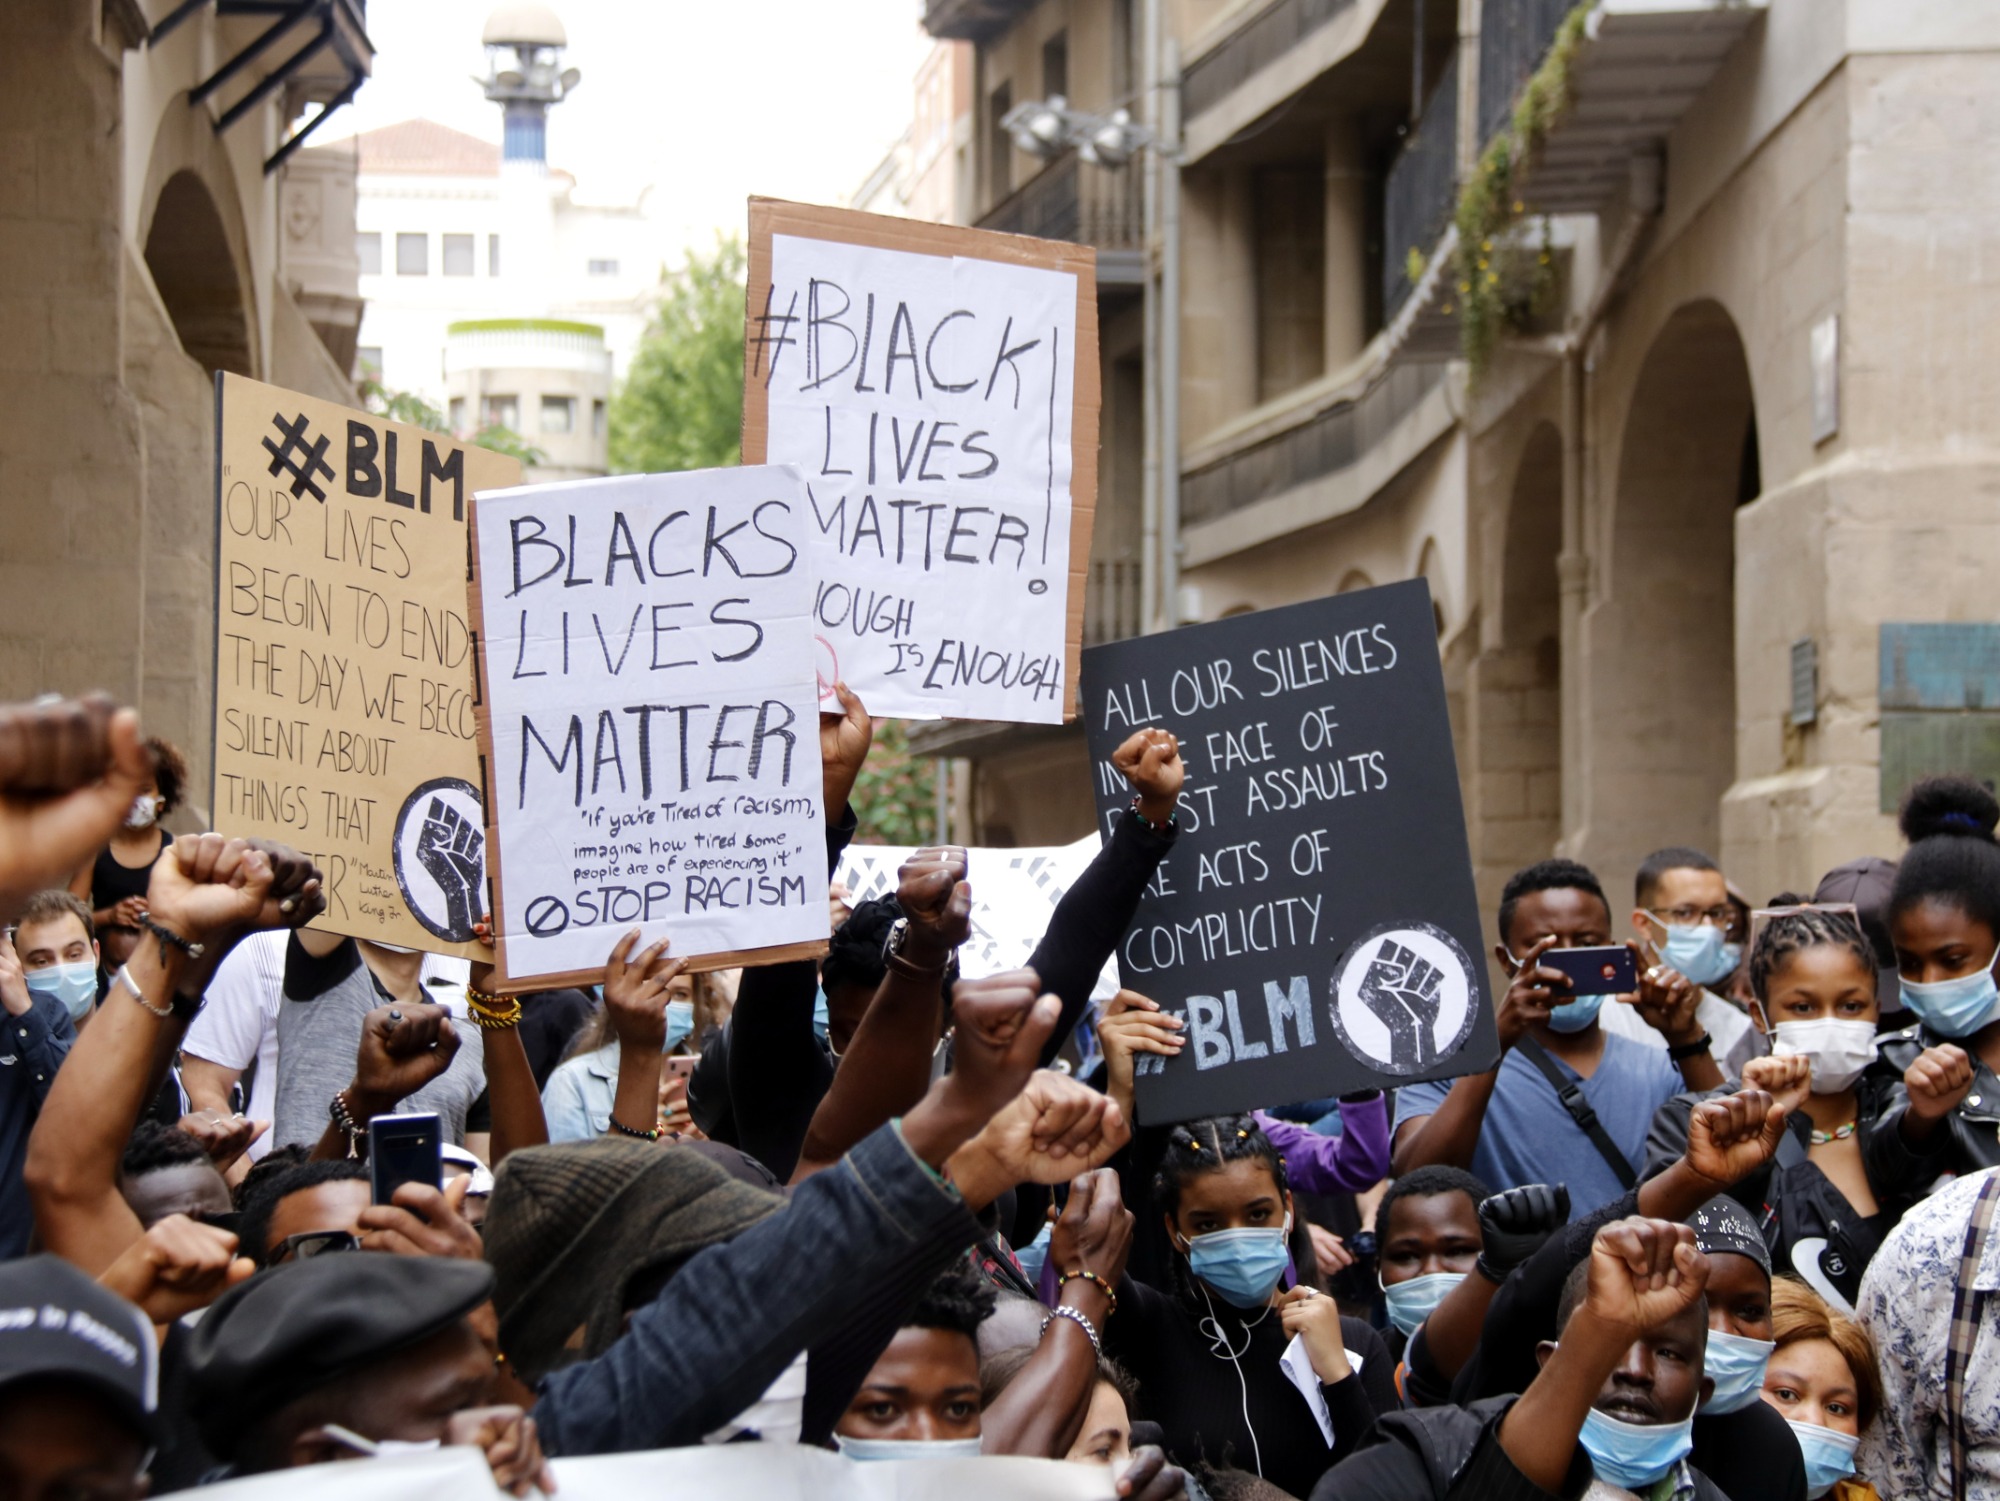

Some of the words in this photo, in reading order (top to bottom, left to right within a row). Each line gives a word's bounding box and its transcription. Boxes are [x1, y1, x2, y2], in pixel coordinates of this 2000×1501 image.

[749, 277, 1042, 411] #BLACK
[260, 411, 465, 523] #BLM
[820, 405, 1000, 486] LIVES
[324, 504, 411, 579] LIVES
[504, 500, 798, 599] BLACKS
[229, 560, 332, 636] BEGIN
[345, 584, 390, 649] TO
[401, 600, 469, 669] END
[512, 597, 765, 681] LIVES
[813, 580, 915, 639] OUGH
[223, 632, 287, 698] THE
[299, 649, 348, 711] DAY
[357, 665, 407, 725] WE
[921, 638, 1062, 702] ENOUGH
[1103, 678, 1164, 732] ALL
[1170, 658, 1245, 717] OUR
[1252, 622, 1398, 698] SILENCES
[224, 708, 310, 766] SILENT
[317, 728, 396, 777] ABOUT
[517, 699, 798, 811] MATTER
[1098, 759, 1129, 797] IN
[1206, 722, 1277, 774] FACE
[1300, 705, 1340, 752] OF
[220, 773, 309, 830] THINGS
[320, 790, 378, 846] THAT
[704, 796, 726, 819] of
[1247, 750, 1389, 818] ASSAULTS
[359, 861, 394, 882] Martin
[573, 841, 642, 865] imagine
[648, 836, 687, 856] how
[694, 831, 737, 850] tired
[742, 832, 787, 850] some
[573, 863, 621, 886] people
[626, 863, 650, 876] are
[656, 854, 678, 875] of
[683, 855, 768, 876] experiencing
[1197, 840, 1269, 893] ACTS
[1290, 828, 1331, 877] OF
[358, 899, 385, 925] King
[359, 881, 395, 899] Luther
[572, 881, 671, 927] STOP
[684, 874, 806, 915] RACISM
